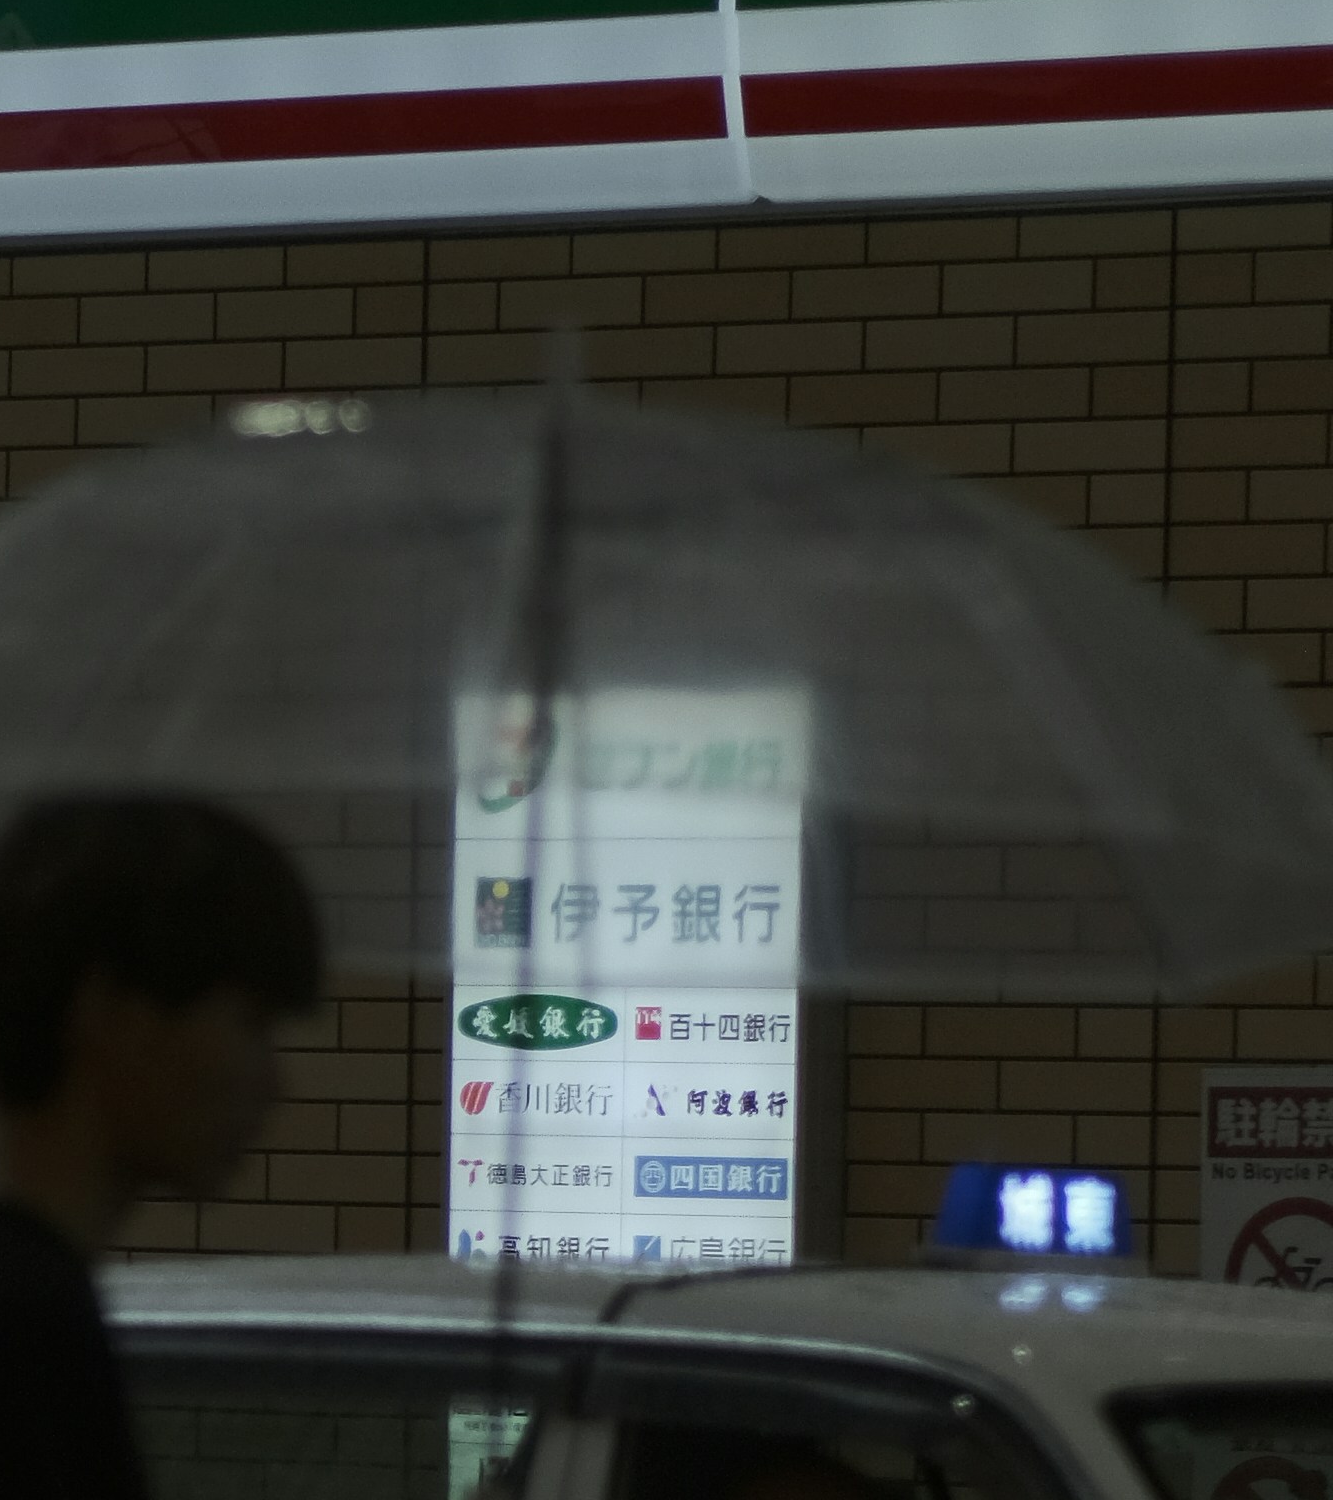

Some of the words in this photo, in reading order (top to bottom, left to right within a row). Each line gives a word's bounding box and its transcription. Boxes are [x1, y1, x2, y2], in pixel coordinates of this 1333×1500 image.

[550, 883, 781, 943] 伊予銀行
[669, 1013, 791, 1043] 百十四銀行
[495, 1080, 614, 1117] 香川銀行
[486, 1163, 614, 1188] 徳島大正銀行
[1213, 1162, 1237, 1180] No
